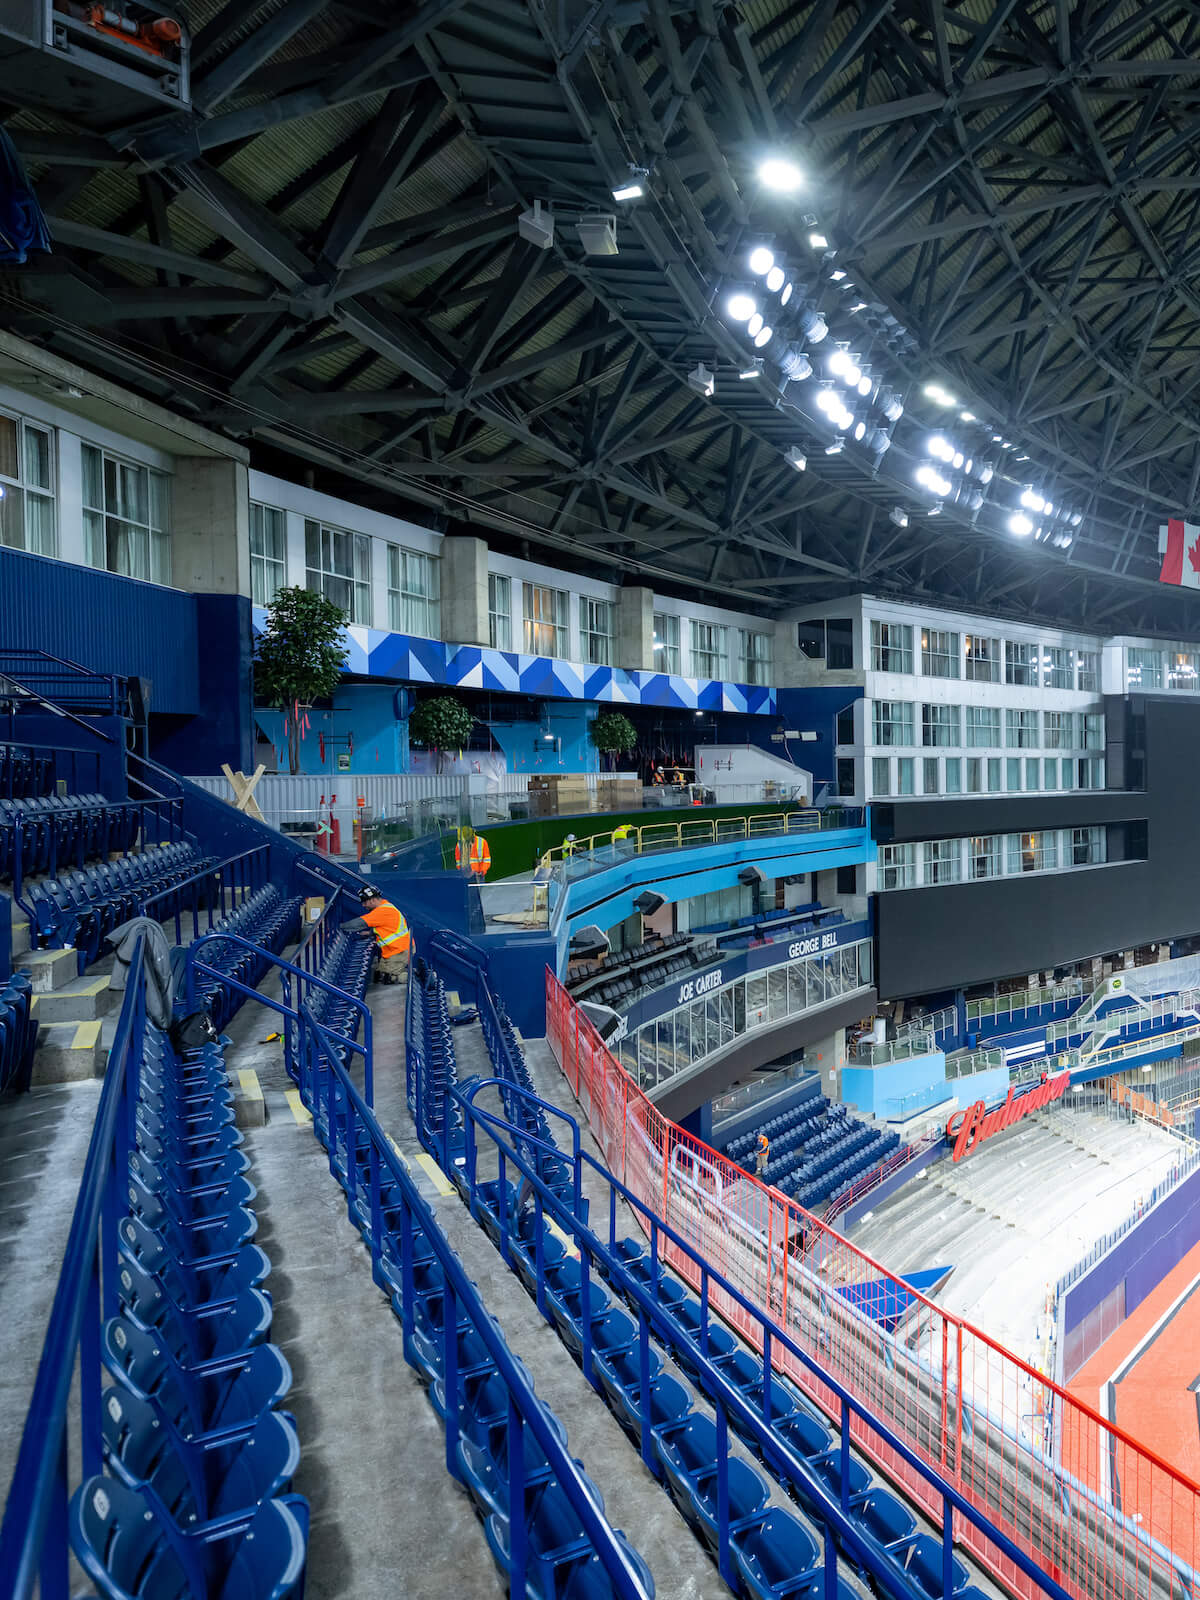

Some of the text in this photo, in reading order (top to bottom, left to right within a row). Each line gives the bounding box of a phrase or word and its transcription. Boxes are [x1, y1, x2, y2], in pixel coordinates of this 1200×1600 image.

[789, 932, 837, 958] GEORGE BELL
[677, 969, 722, 1004] JOE CARTER
[946, 1070, 1071, 1162] Budweiser
